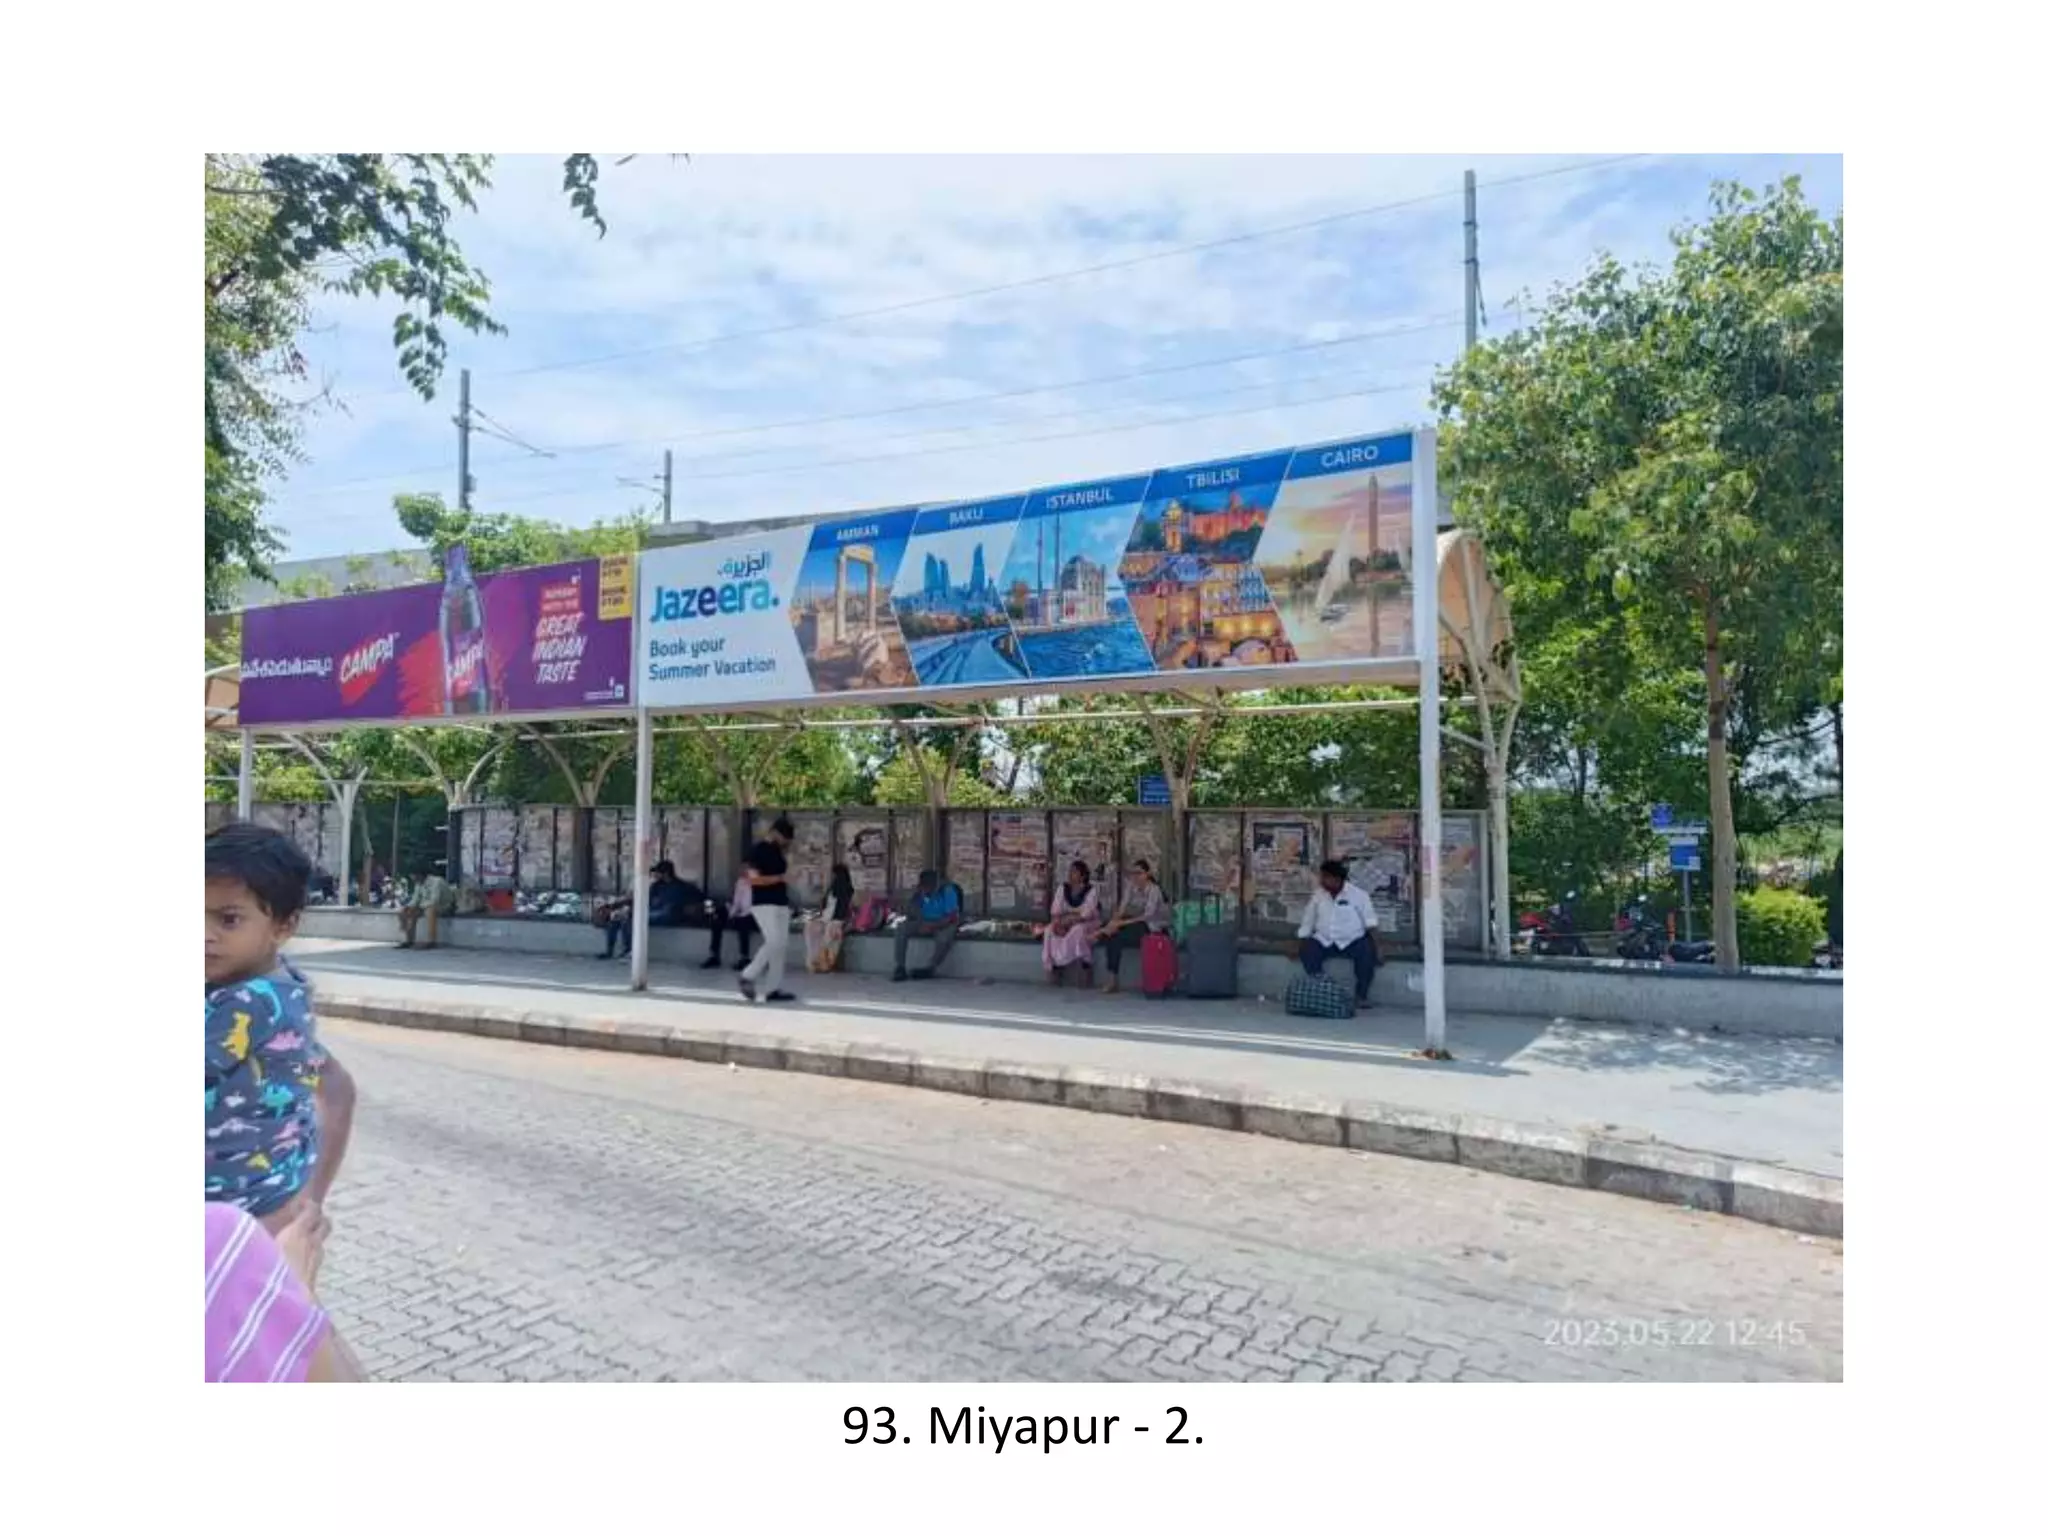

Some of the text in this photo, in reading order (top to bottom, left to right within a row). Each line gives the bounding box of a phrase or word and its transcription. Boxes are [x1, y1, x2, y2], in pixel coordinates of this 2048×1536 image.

[1320, 445, 1379, 469] CAIRO
[1186, 467, 1241, 489] TBILISI
[1046, 487, 1115, 510] ISTANBUL
[948, 507, 984, 525] BAKU
[836, 524, 879, 541] AMMAN
[649, 579, 779, 623] Jazeera.
[535, 612, 584, 637] GREAT
[532, 636, 588, 662] INDIAN
[650, 638, 725, 659] Book your
[536, 660, 581, 684] TASTE
[648, 657, 776, 680] Summer Vacation
